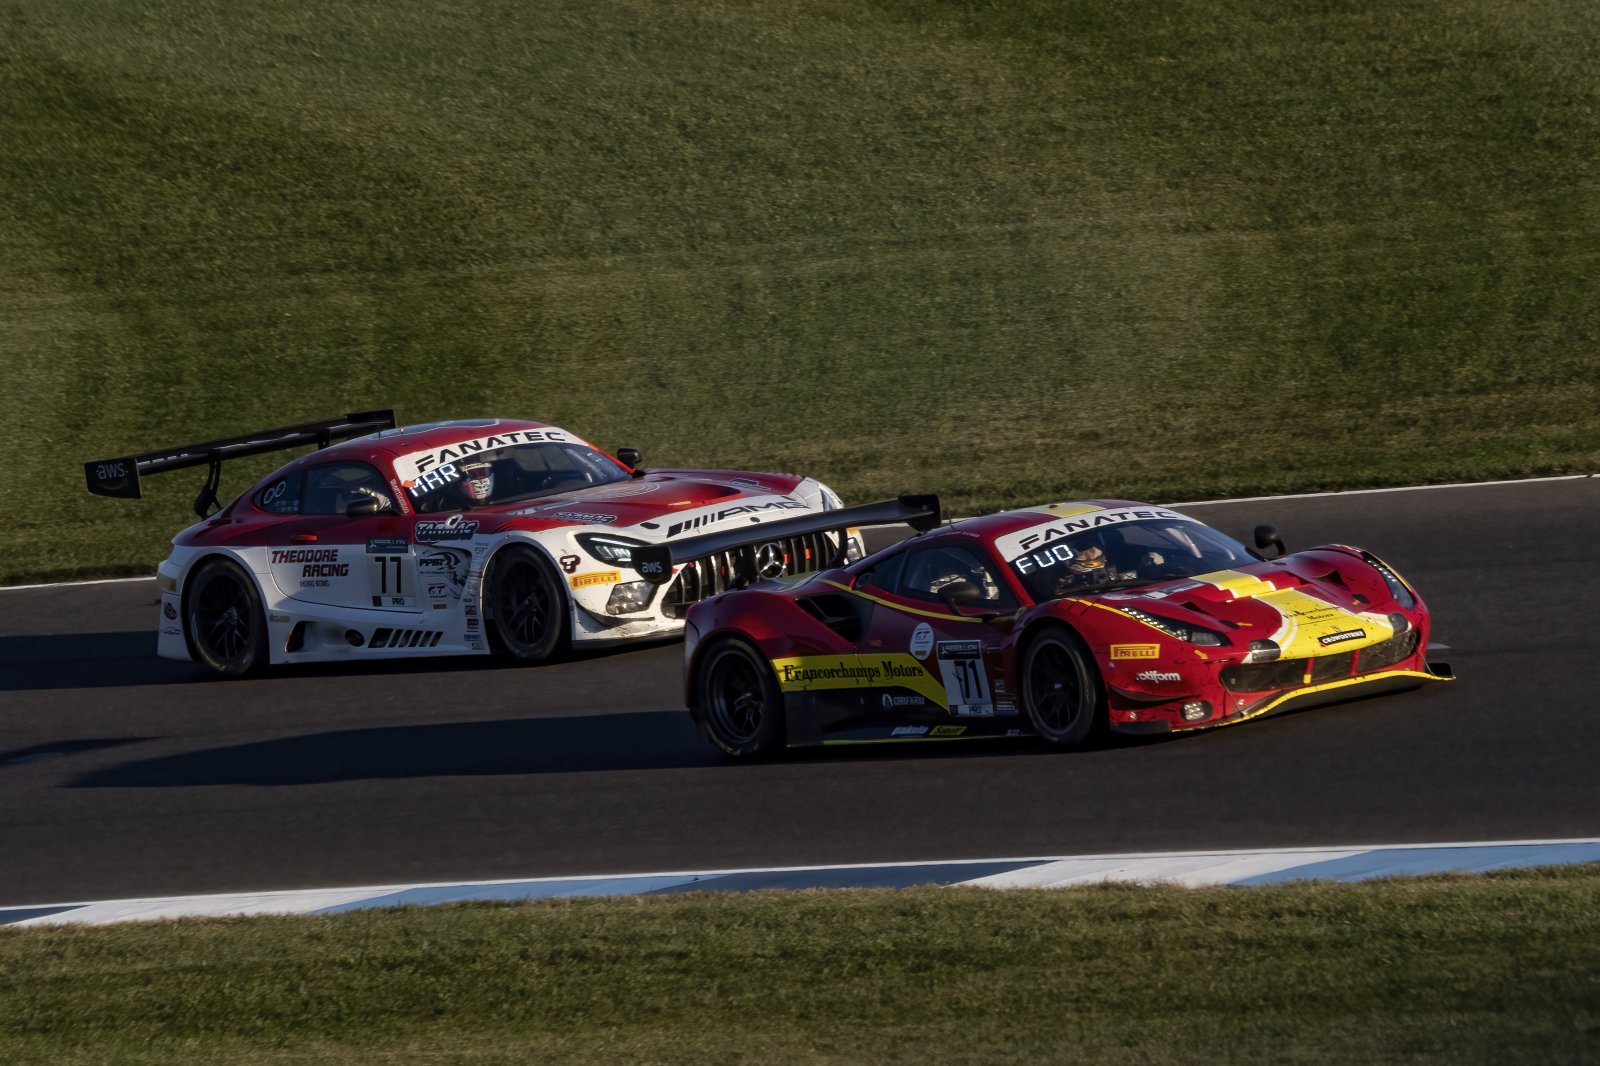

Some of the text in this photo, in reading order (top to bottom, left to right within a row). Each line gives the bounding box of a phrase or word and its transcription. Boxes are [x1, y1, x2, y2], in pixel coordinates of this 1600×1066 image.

[415, 431, 565, 474] FANATEC
[98, 463, 125, 480] aws
[409, 463, 460, 498] MAR
[717, 496, 811, 521] AMG
[1019, 511, 1178, 551] FANATEC
[271, 549, 339, 564] THEODORE
[641, 561, 663, 574] aws
[1015, 544, 1074, 575] FUO
[302, 563, 349, 578] RACING
[375, 556, 402, 594] 77
[572, 572, 617, 588] PIRELLI
[392, 597, 405, 606] PRO
[1113, 645, 1156, 658] PIRELLI
[783, 660, 924, 682] Francorchamps Motors
[954, 660, 983, 699] 71
